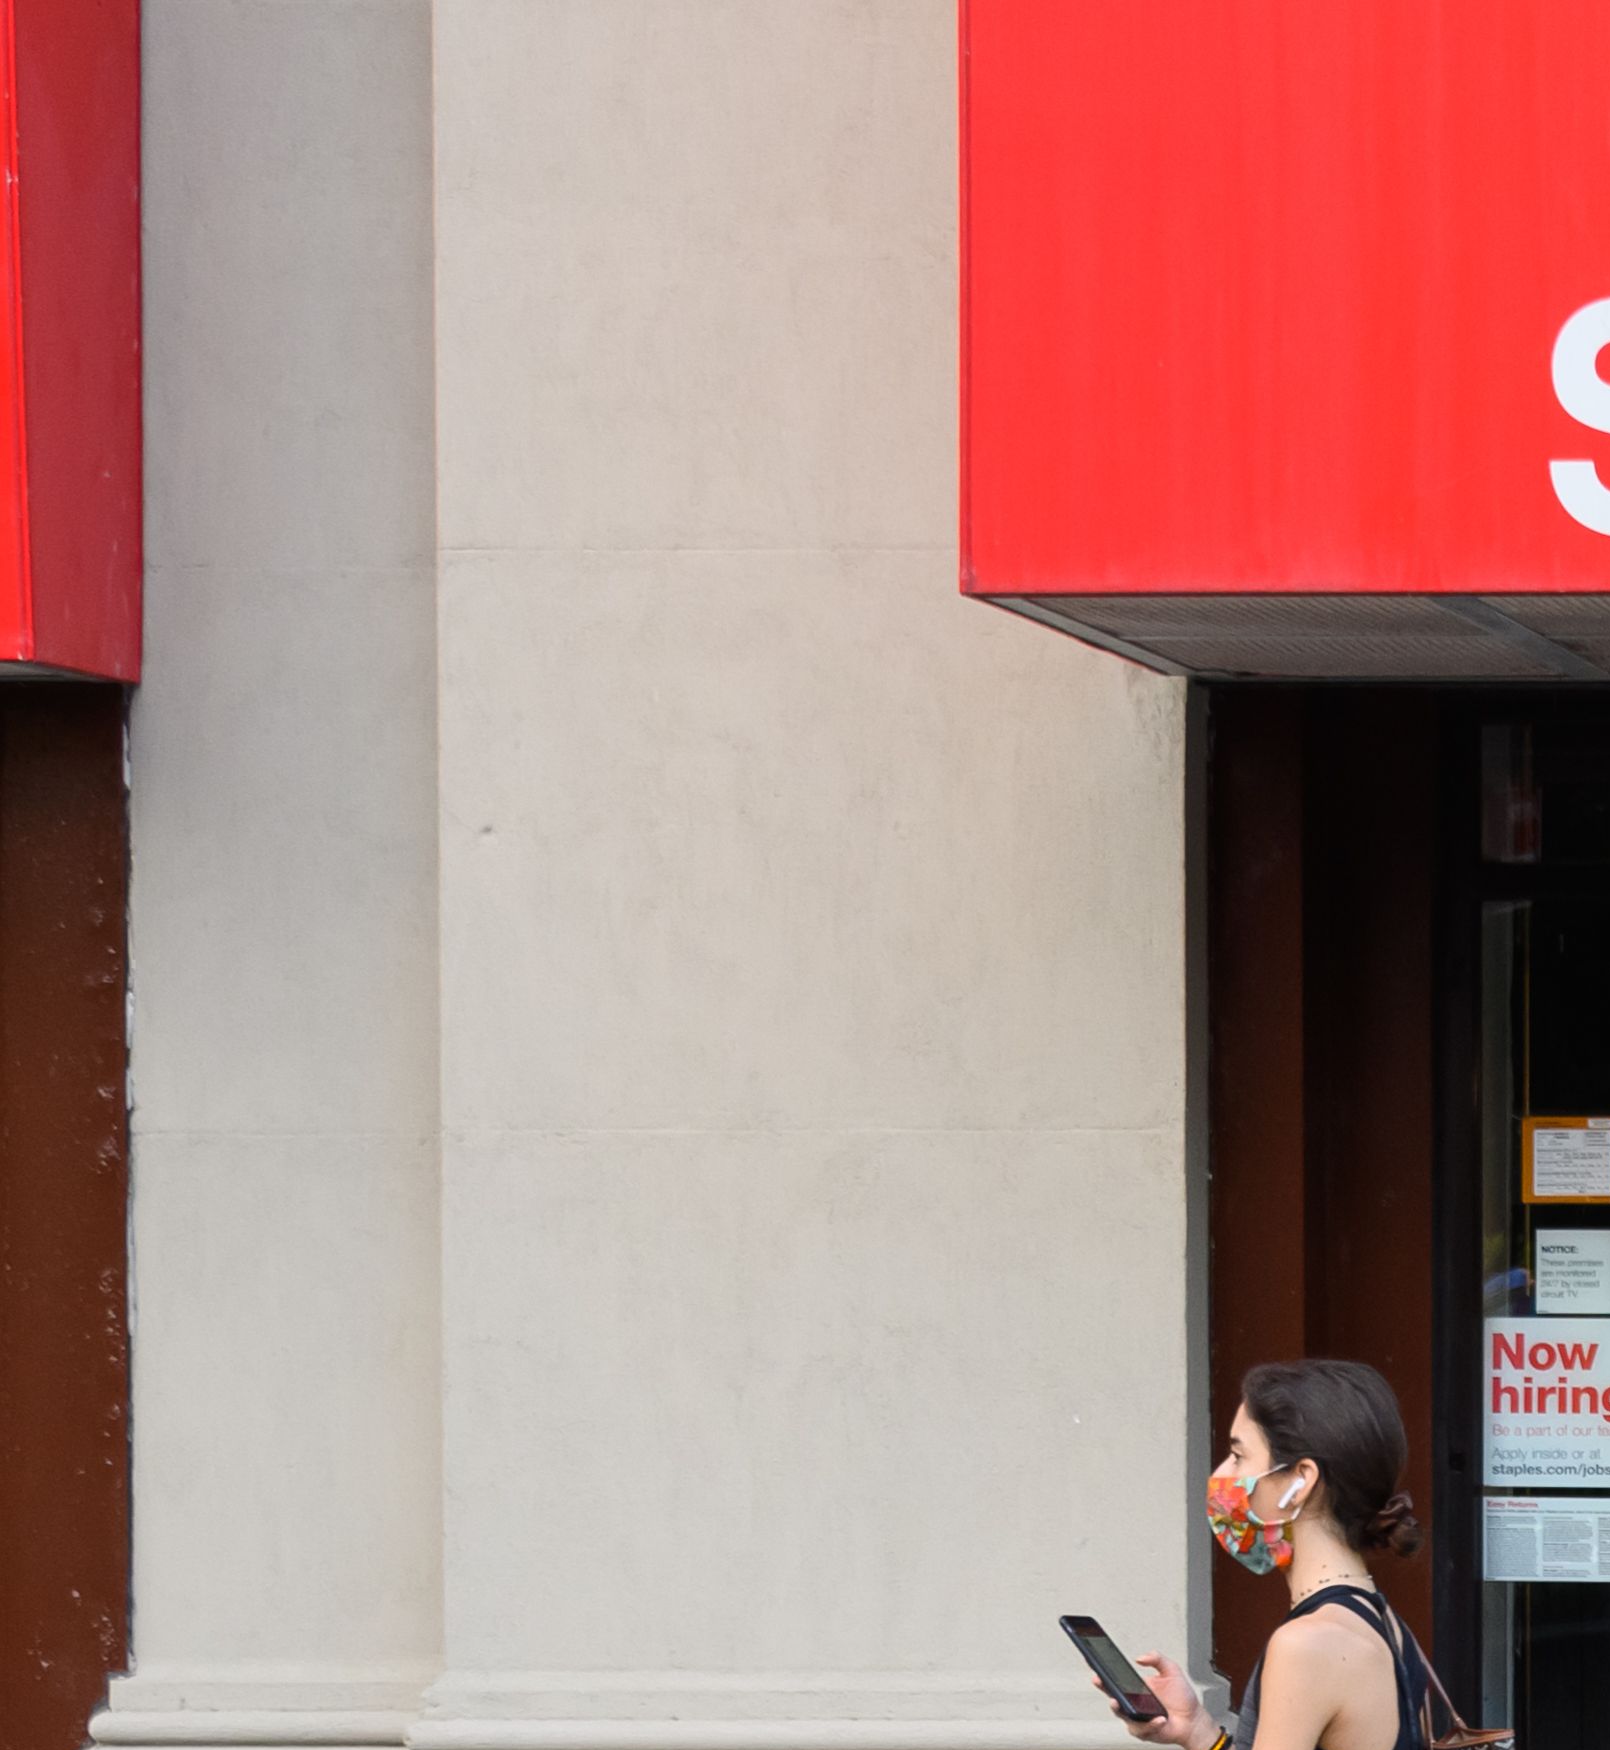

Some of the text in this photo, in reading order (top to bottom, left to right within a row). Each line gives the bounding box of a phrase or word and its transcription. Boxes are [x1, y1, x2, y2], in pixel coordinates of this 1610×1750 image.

[1541, 1245, 1579, 1254] NOTICE:
[1492, 1332, 1599, 1371] Now
[1492, 1424, 1510, 1437] Be
[1514, 1428, 1522, 1437] a
[1526, 1425, 1551, 1439] part
[1556, 1424, 1568, 1437] of
[1572, 1428, 1593, 1437] our
[1491, 1447, 1601, 1462] Apply inside or at
